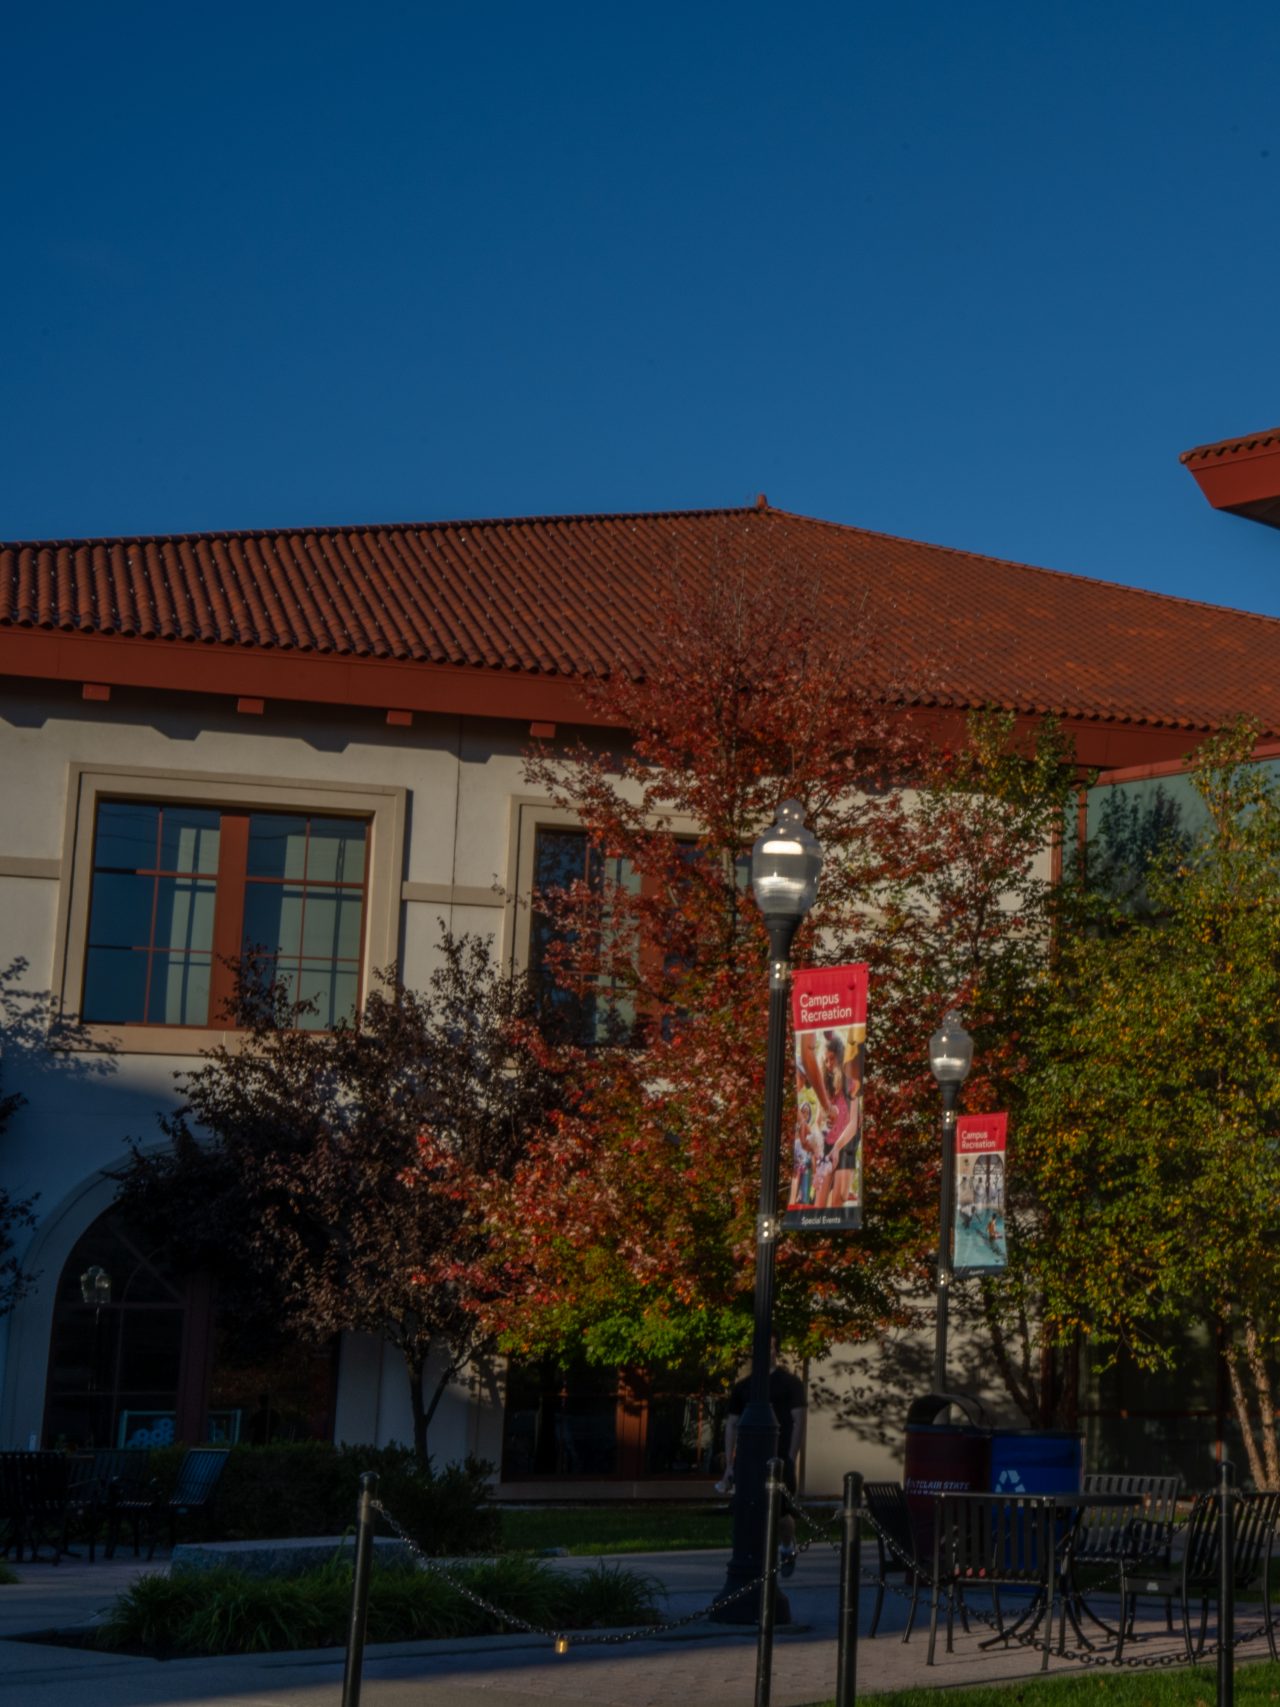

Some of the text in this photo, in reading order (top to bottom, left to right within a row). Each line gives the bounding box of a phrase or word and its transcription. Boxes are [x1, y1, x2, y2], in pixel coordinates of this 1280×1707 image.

[800, 993, 840, 1009] Campus
[800, 1006, 852, 1023] Recreation
[961, 1130, 988, 1141] Campus
[961, 1140, 996, 1150] Recreation
[801, 1216, 841, 1227] Special Events
